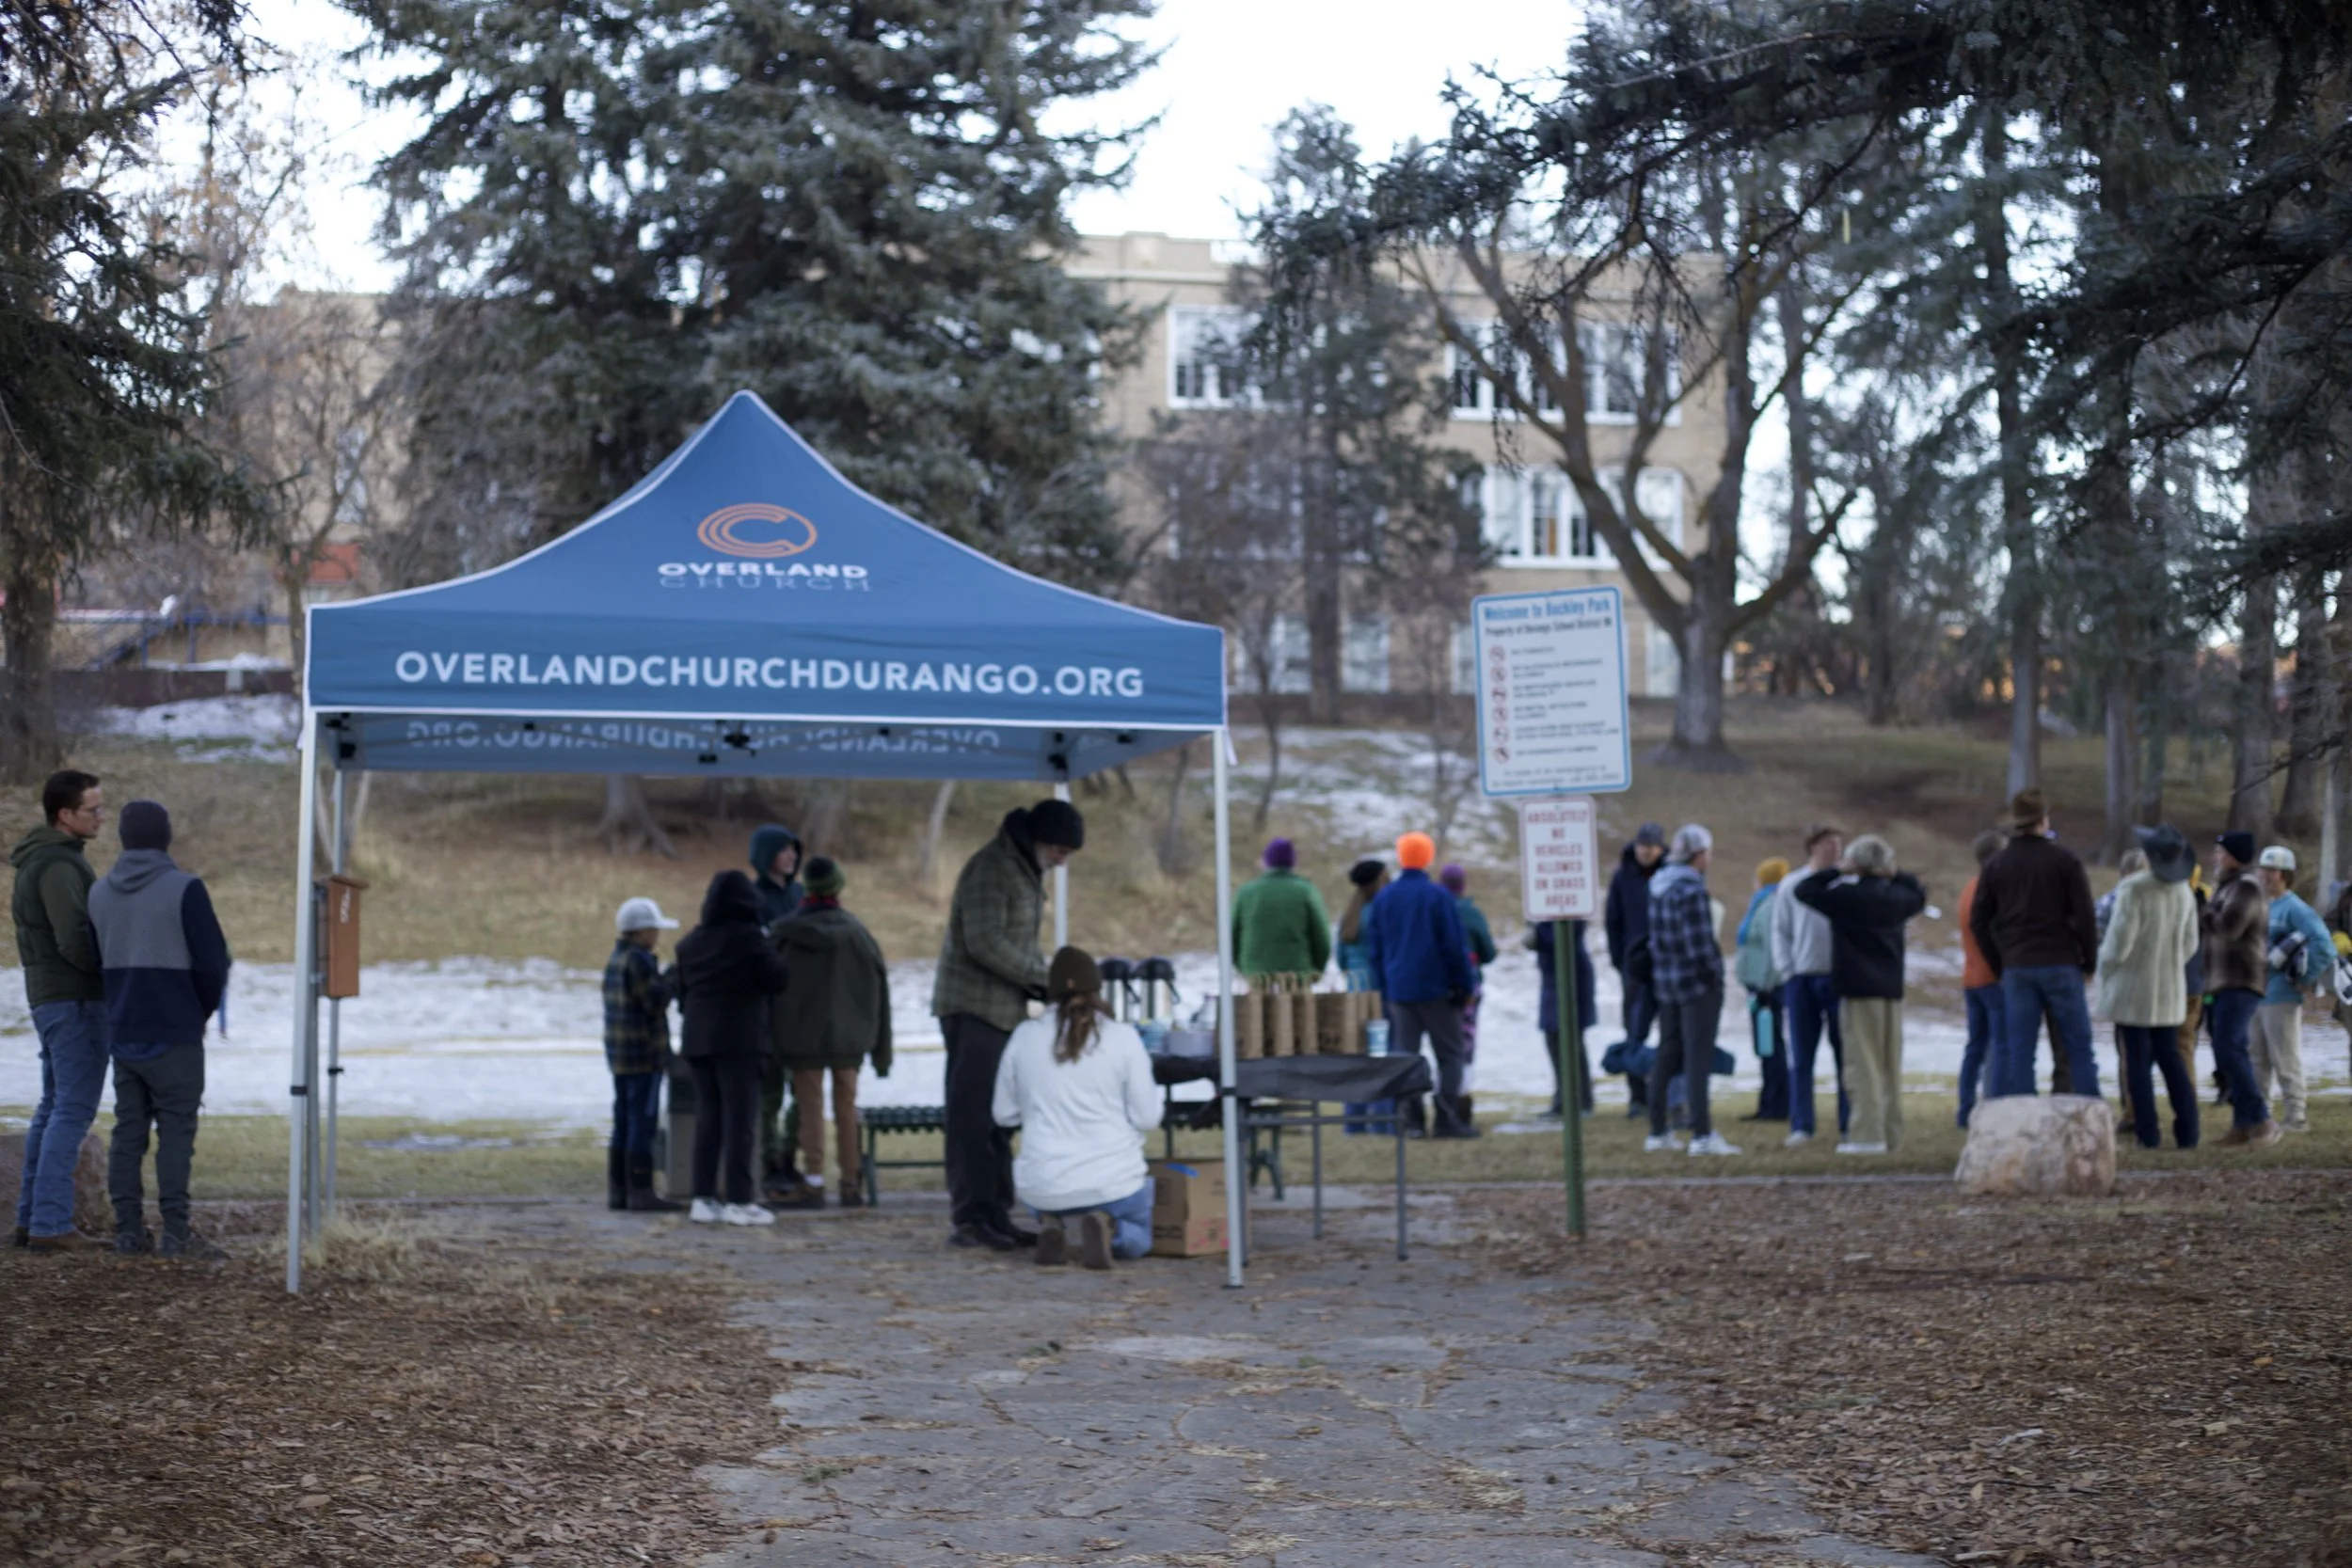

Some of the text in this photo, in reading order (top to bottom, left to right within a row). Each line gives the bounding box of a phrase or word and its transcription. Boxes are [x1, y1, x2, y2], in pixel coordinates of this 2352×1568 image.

[658, 562, 869, 579] OVERLAND
[660, 575, 871, 592] CHURCH
[394, 650, 1145, 700] OVERLANDCHURCHDURANGO.ORG
